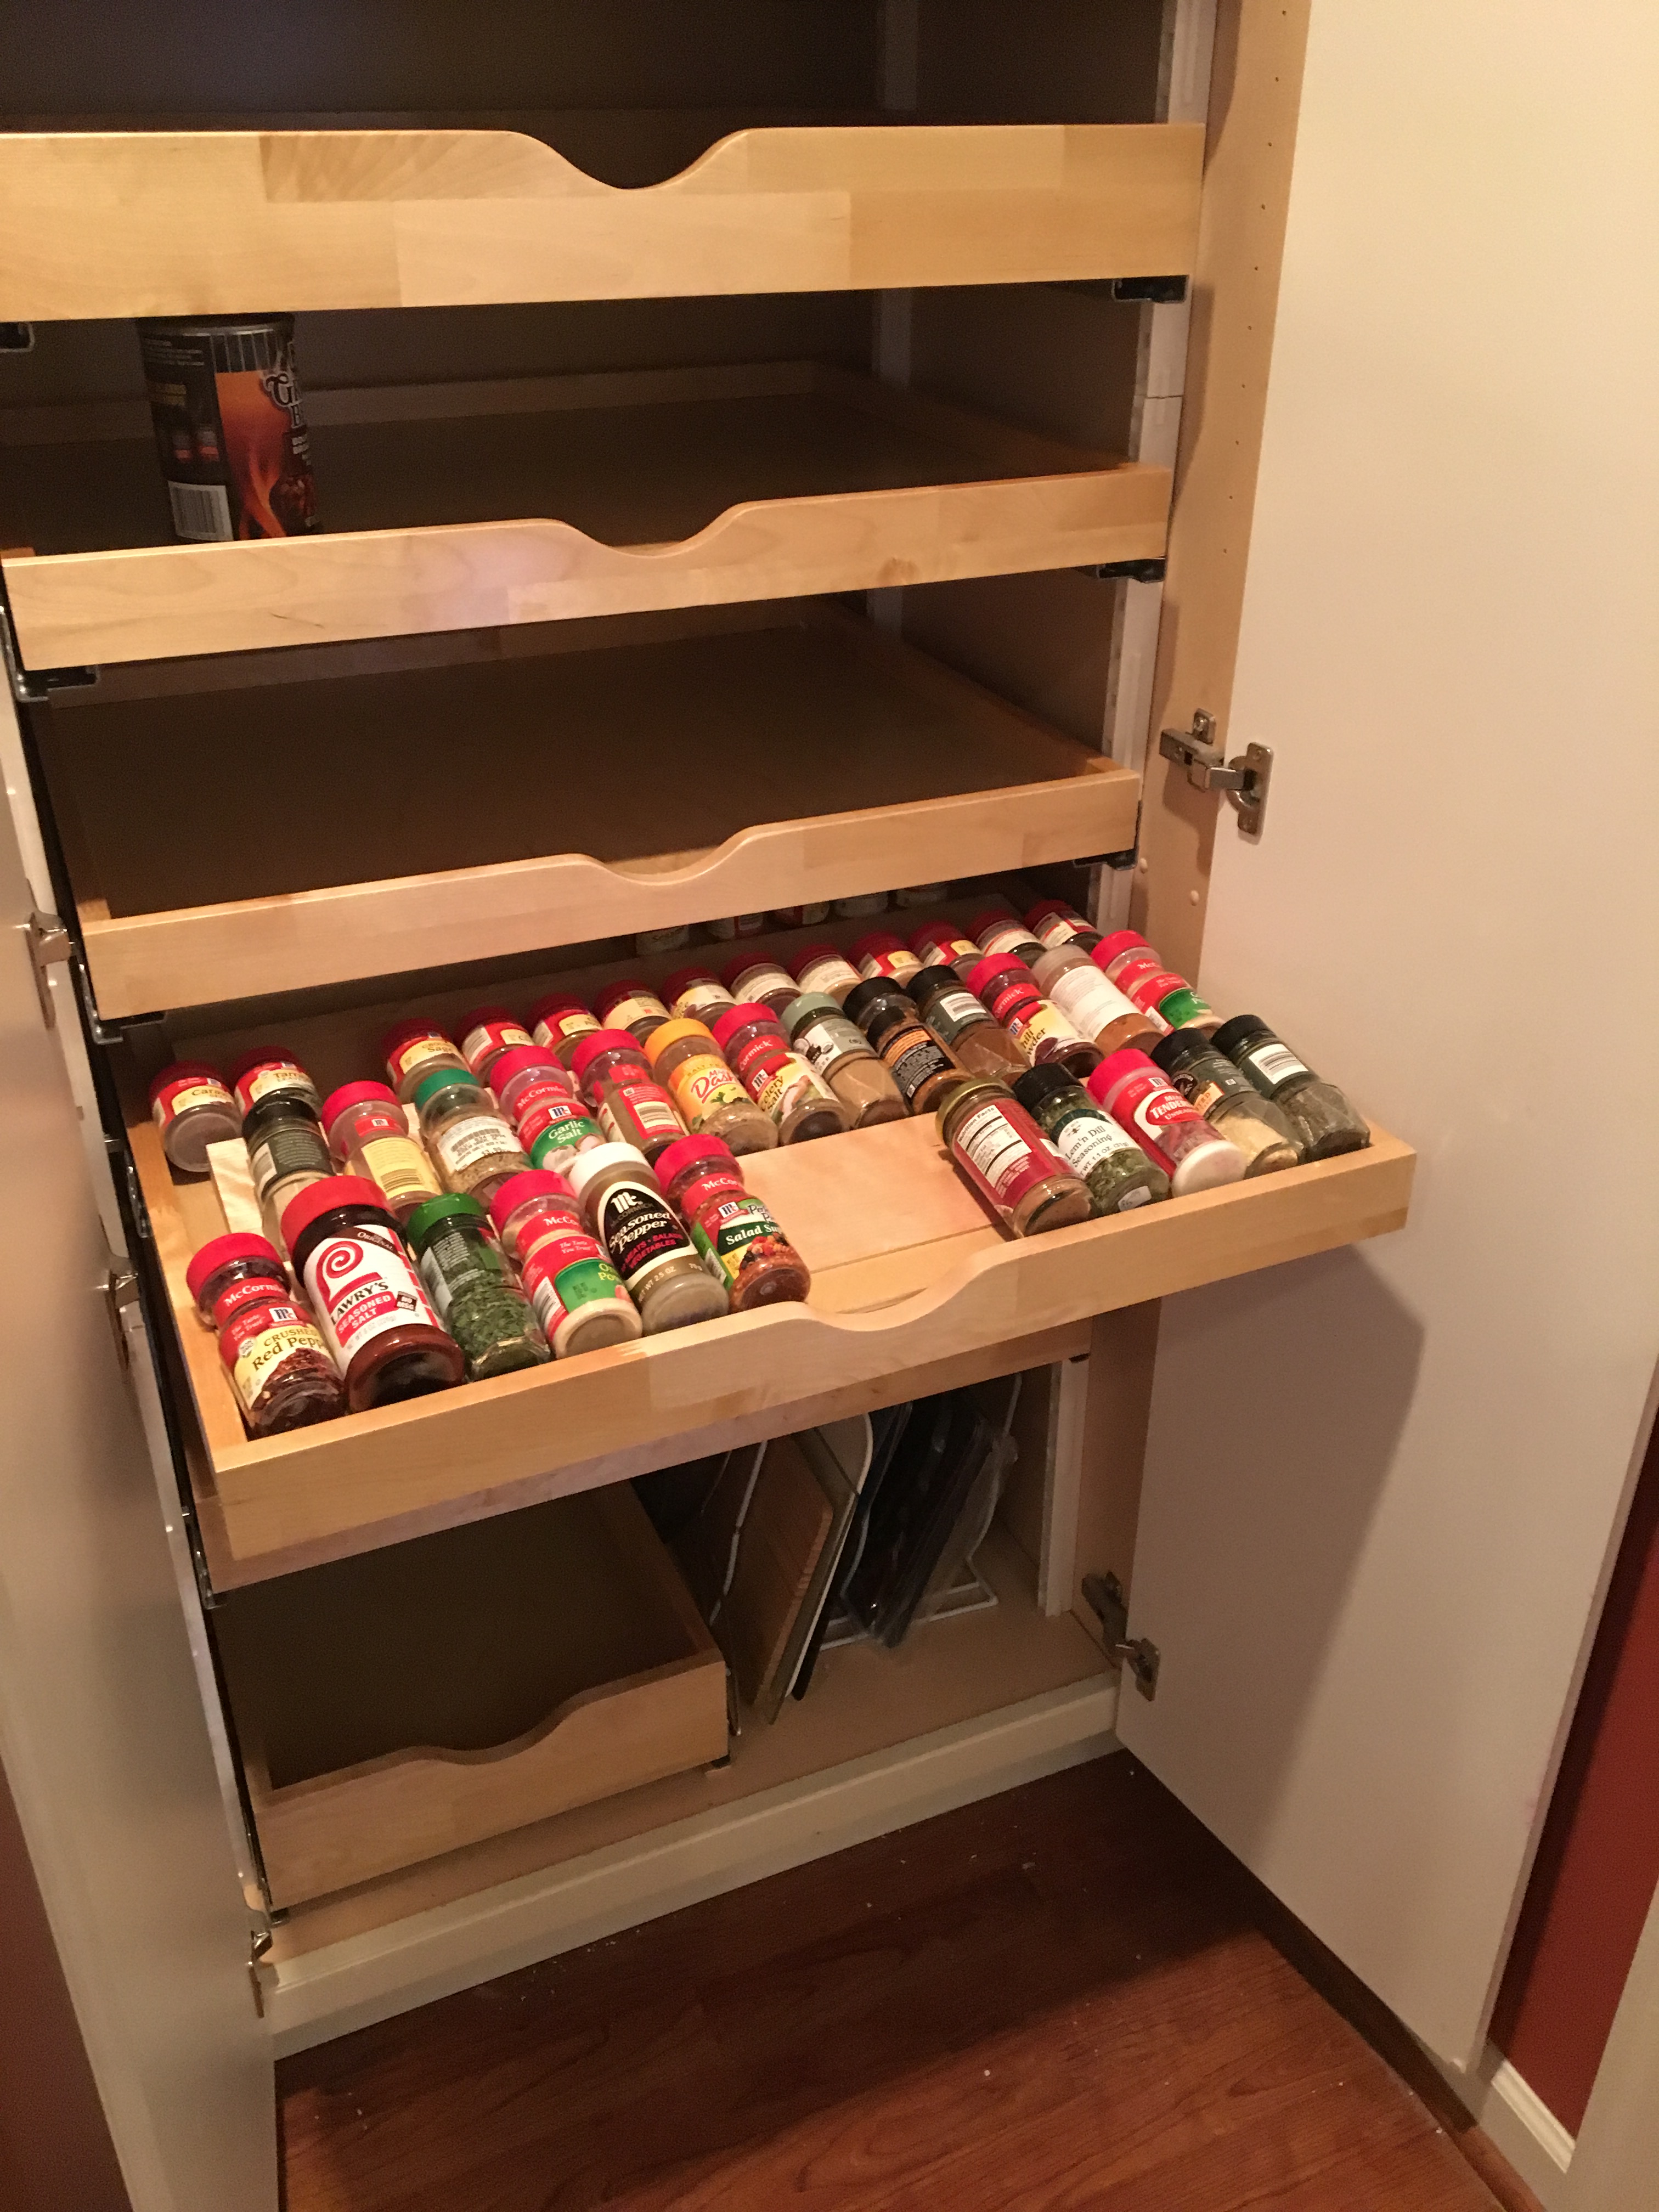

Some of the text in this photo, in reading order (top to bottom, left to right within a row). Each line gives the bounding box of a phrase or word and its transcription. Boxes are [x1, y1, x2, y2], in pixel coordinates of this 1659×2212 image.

[977, 1108, 995, 1119] Facts
[549, 1120, 585, 1139] Garlic
[557, 1128, 582, 1143] Salt
[1087, 1125, 1106, 1137] Dill
[1072, 1134, 1113, 1167] Seasoning
[726, 1225, 763, 1245] Salad
[329, 1281, 389, 1325] LAWRY'S
[337, 1295, 392, 1334] SEASONED
[351, 1308, 377, 1329] SALT
[252, 1342, 284, 1372] Red
